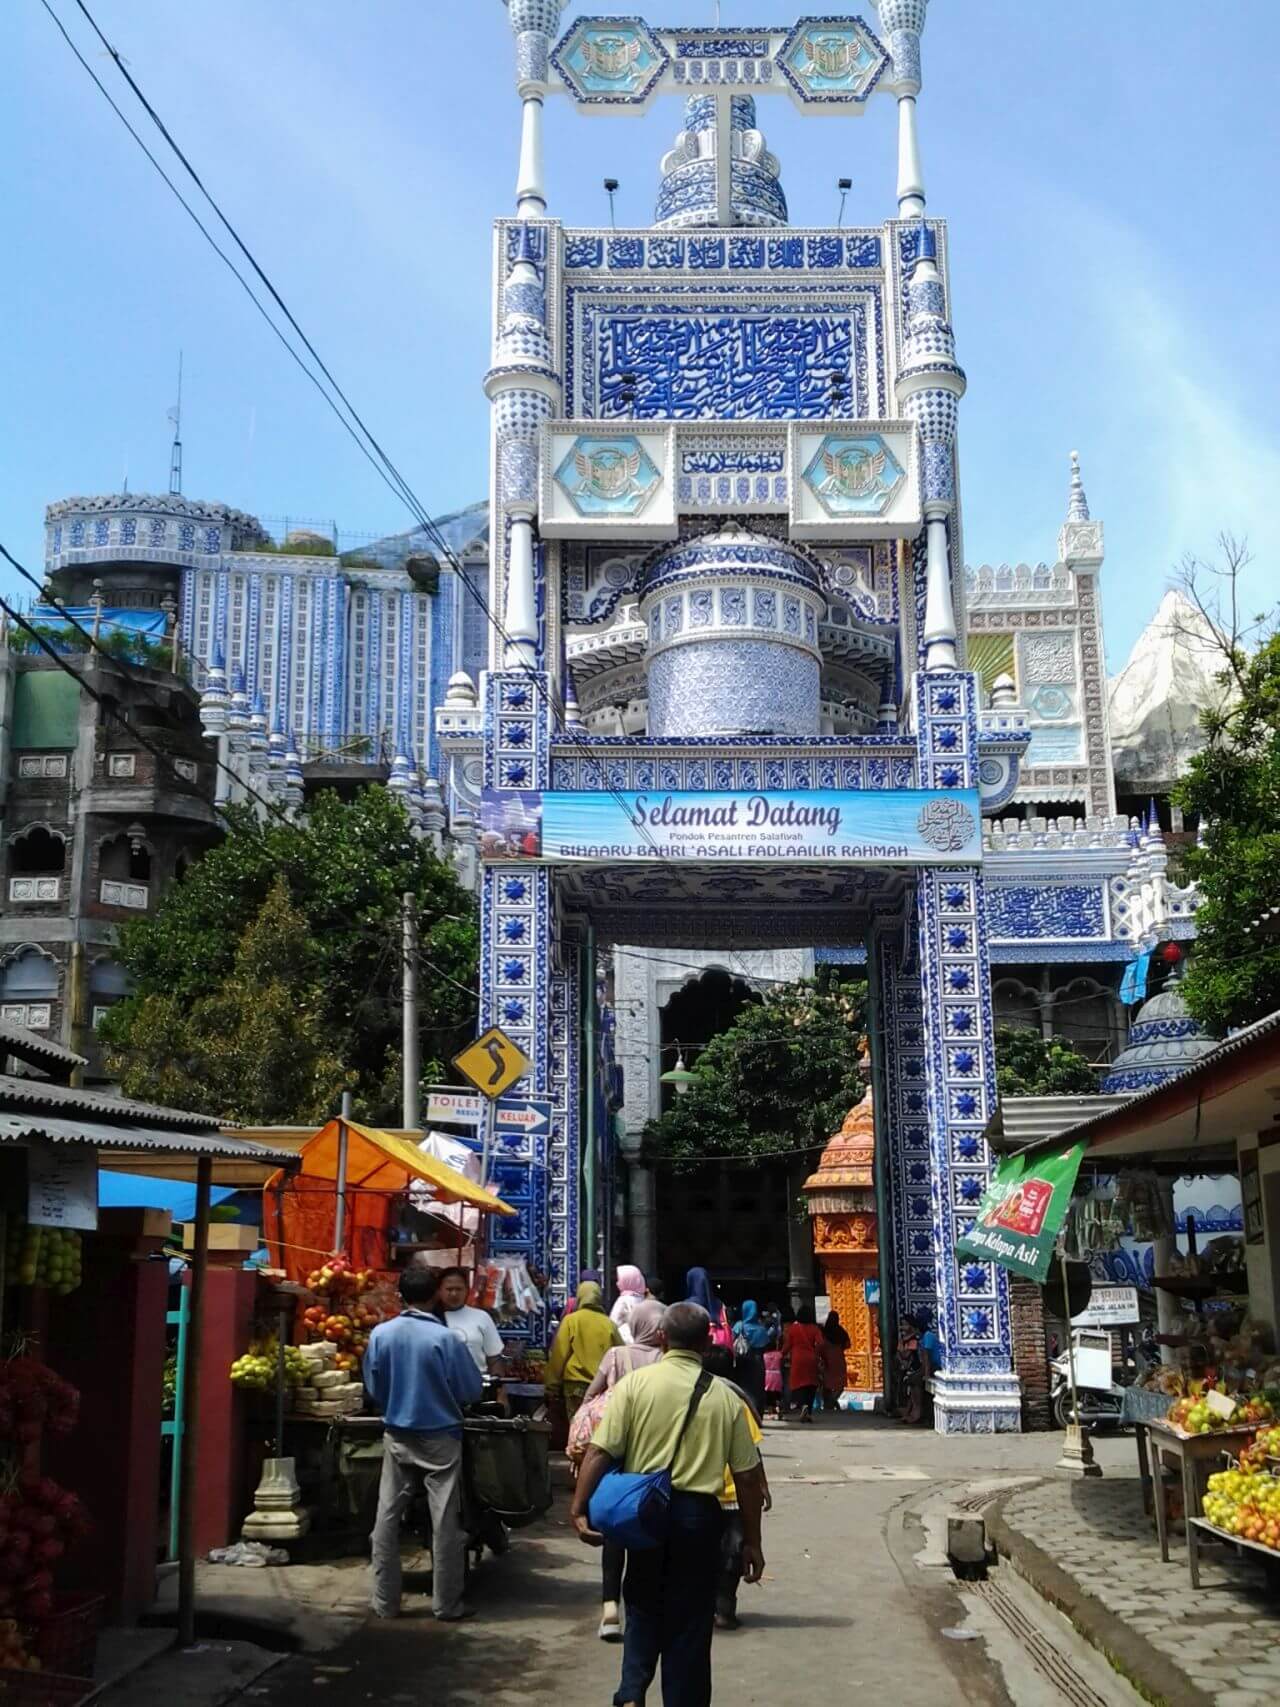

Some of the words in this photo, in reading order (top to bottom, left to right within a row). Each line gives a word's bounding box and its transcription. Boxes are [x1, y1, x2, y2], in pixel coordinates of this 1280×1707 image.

[632, 795, 738, 827] Selamat
[746, 795, 842, 836] Datang
[669, 832, 706, 841] Pondok
[708, 832, 757, 841] Pesantren
[560, 845, 632, 857] BIHAARU
[637, 845, 686, 857] BAHRI
[748, 845, 837, 857] FADLAAILIR
[842, 845, 908, 857] RAHMAH
[432, 1096, 480, 1109] TOILET
[499, 1111, 536, 1123] KELUAR
[1014, 1242, 1040, 1266] Asli
